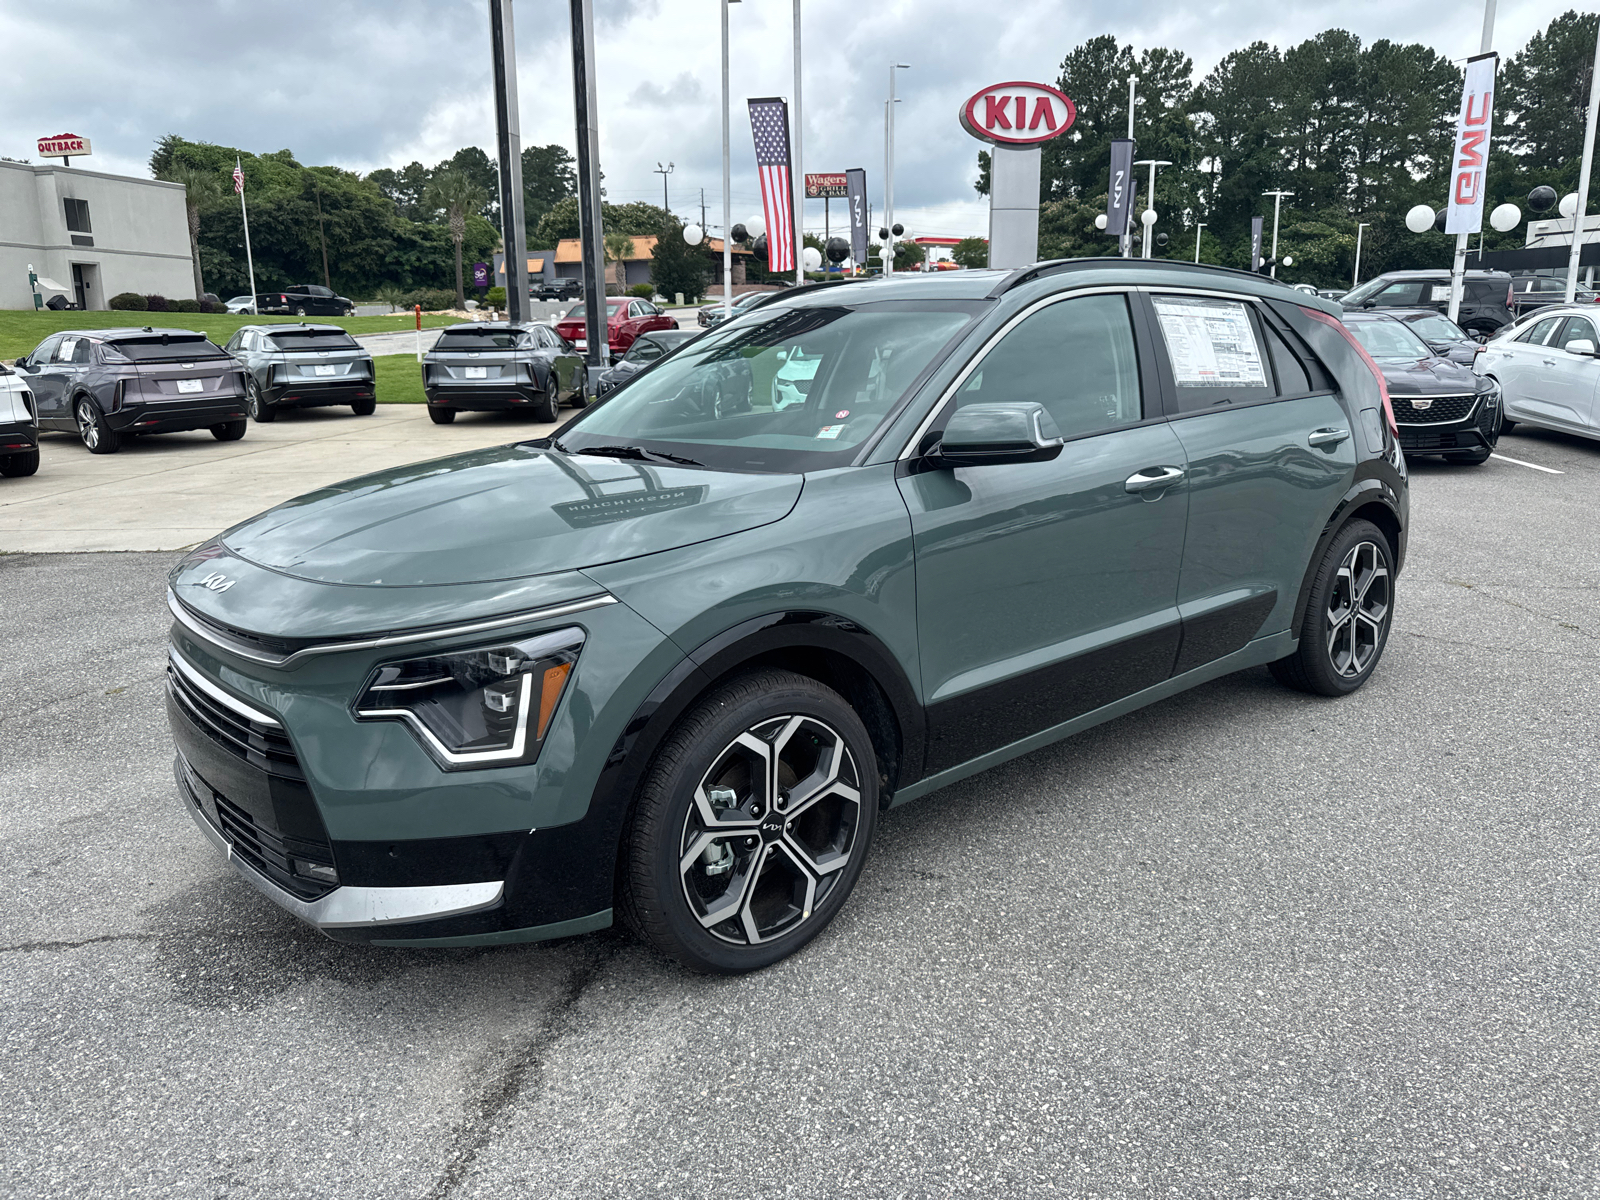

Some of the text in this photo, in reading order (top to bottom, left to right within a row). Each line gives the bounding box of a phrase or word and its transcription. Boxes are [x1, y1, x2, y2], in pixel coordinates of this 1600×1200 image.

[984, 95, 1058, 130] KIA
[37, 140, 84, 153] OUTBACK
[1454, 91, 1492, 205] GMC
[807, 174, 847, 187] Wagers
[200, 571, 237, 594] KIA
